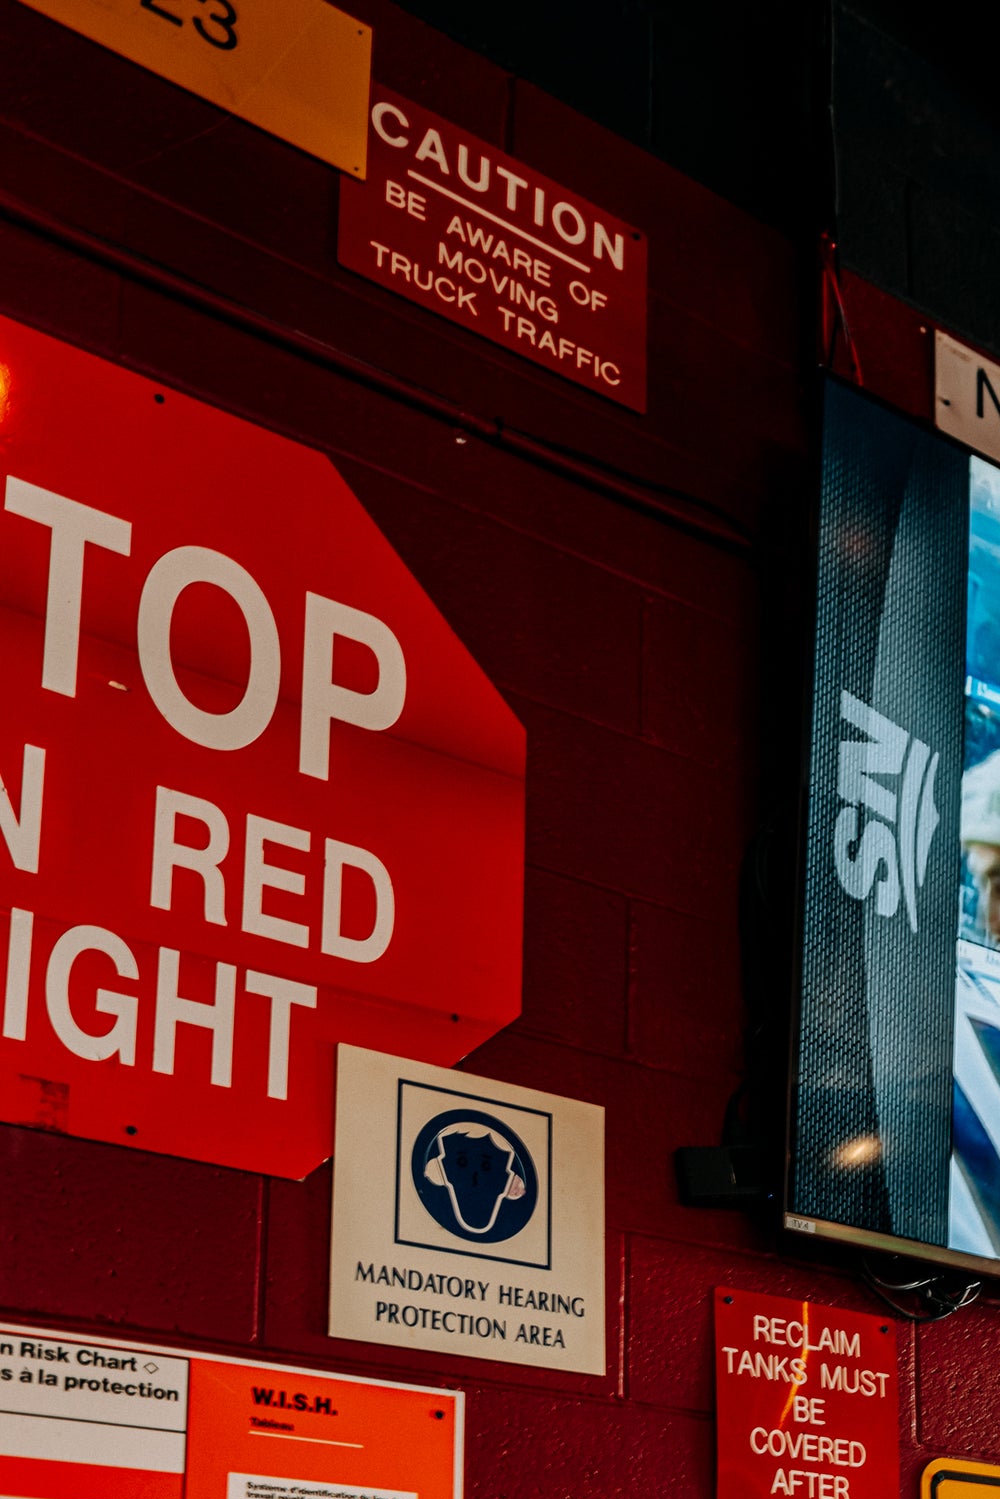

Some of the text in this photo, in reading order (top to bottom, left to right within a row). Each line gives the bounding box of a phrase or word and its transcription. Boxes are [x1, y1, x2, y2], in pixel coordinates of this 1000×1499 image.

[372, 102, 624, 270] CAUTION
[385, 180, 607, 312] BE AWARE OF
[438, 243, 558, 323] MOVING
[371, 241, 621, 386] TRUCK TRAFFIC
[150, 785, 395, 964] RED
[356, 1261, 586, 1318] MANDATORY HEARING
[375, 1300, 566, 1349] PROTECTION AREA
[753, 1314, 862, 1359] RECLAIM
[20, 1342, 138, 1372] Risk Chart
[722, 1346, 890, 1399] TANKS MUST
[38, 1369, 180, 1402] la protection
[252, 1386, 339, 1416] W.I.S.H.
[793, 1395, 826, 1426] BE
[749, 1427, 867, 1468] COVERED
